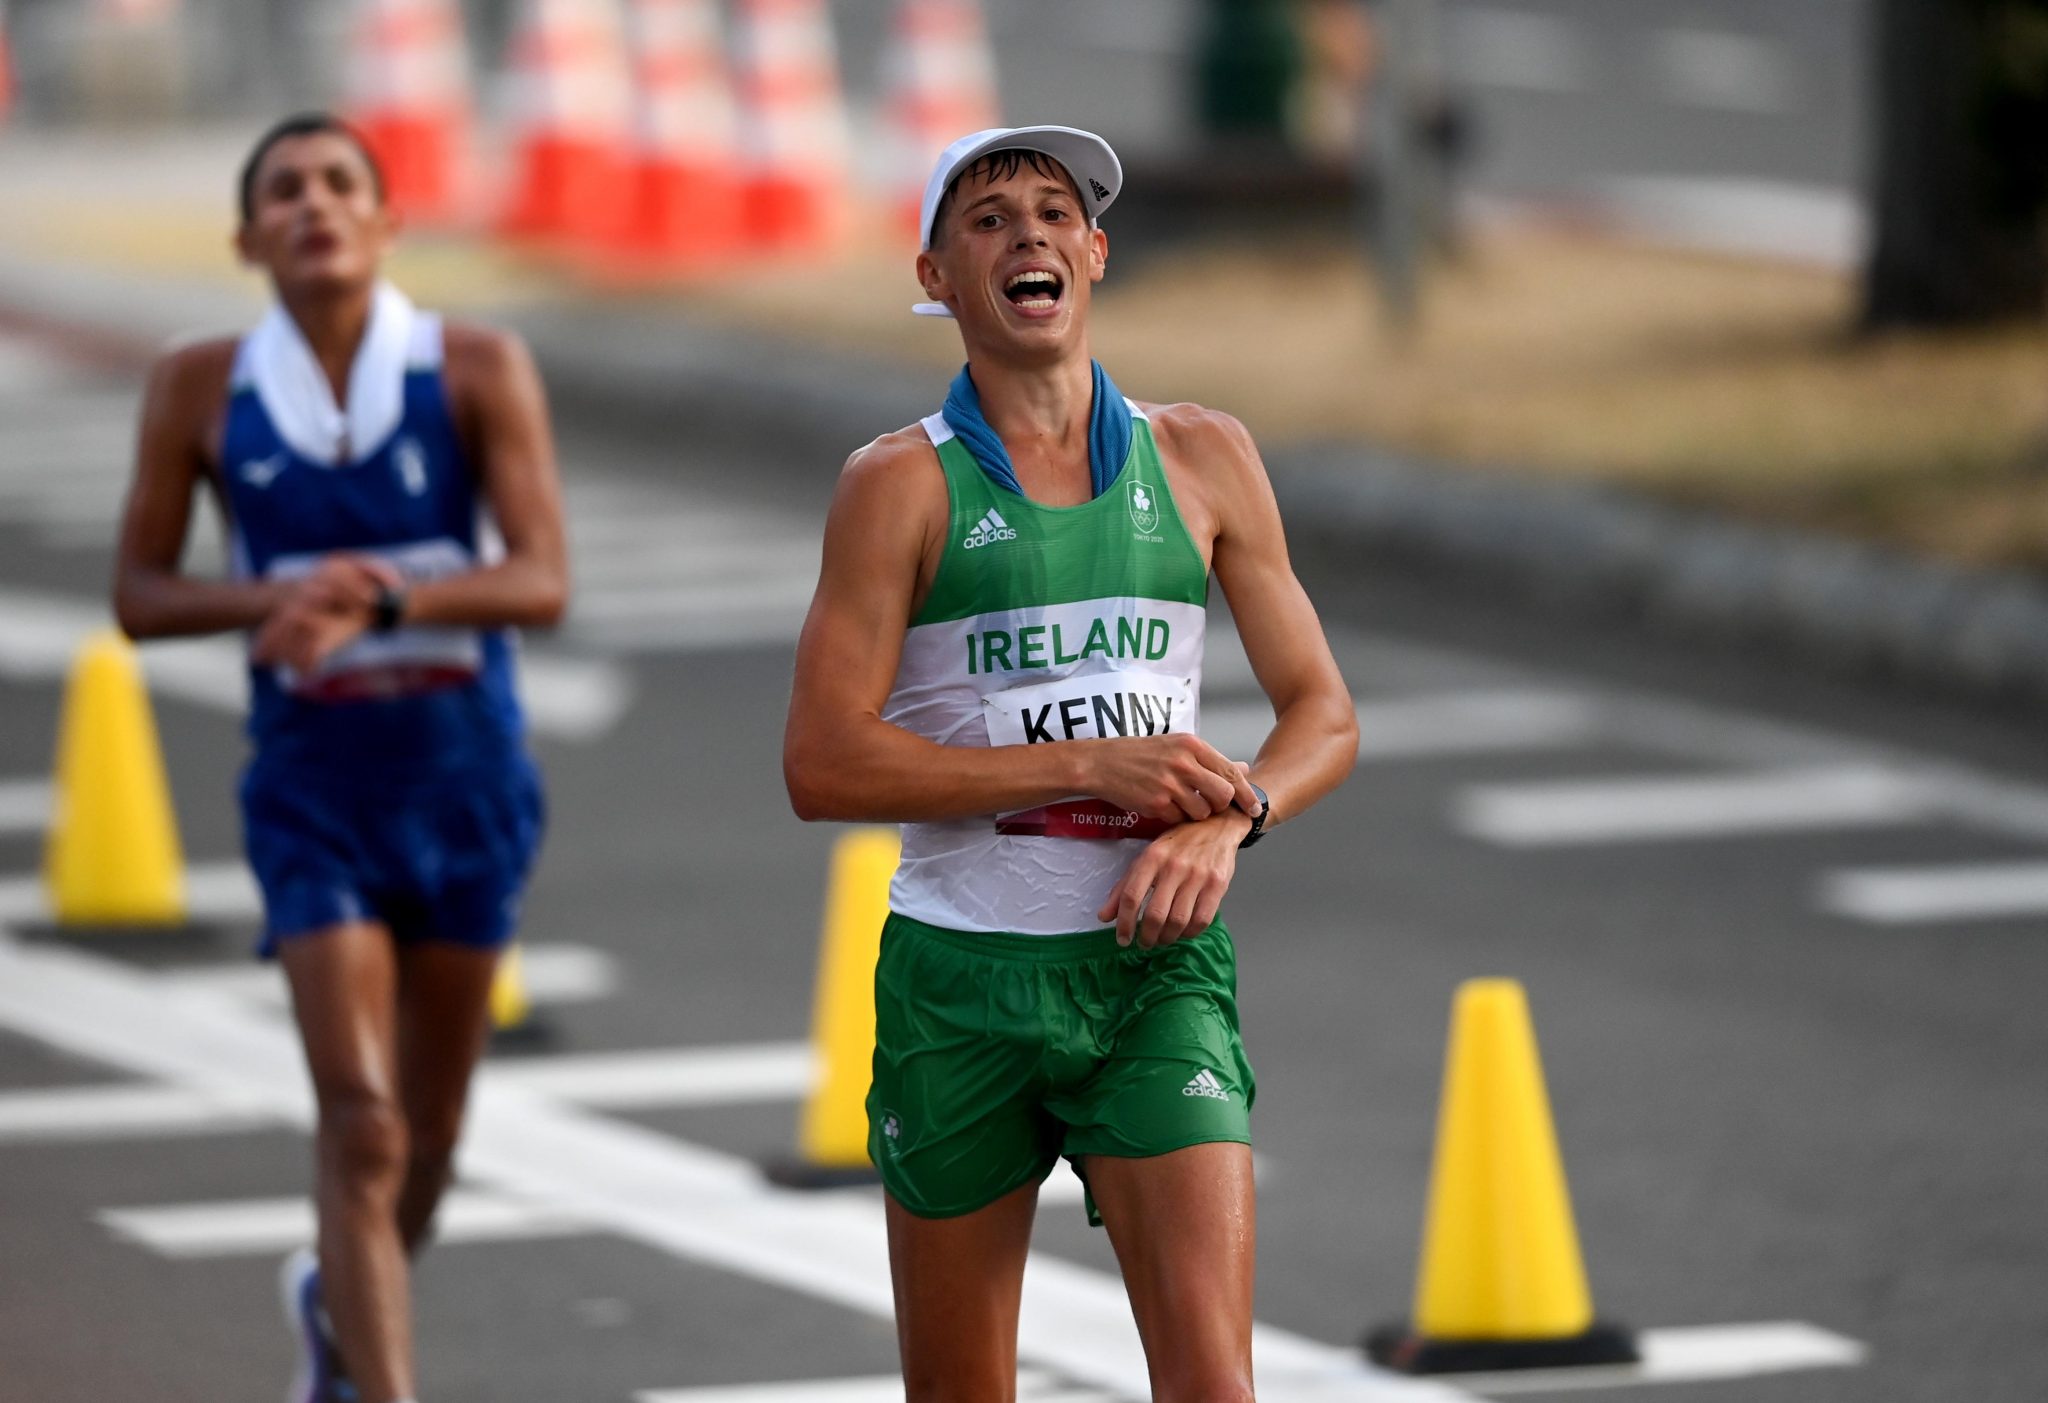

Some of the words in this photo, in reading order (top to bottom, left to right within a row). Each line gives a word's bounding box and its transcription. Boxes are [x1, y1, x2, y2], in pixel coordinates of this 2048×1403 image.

[963, 528, 1017, 549] adidas
[966, 616, 1170, 674] IRELAND
[1021, 692, 1172, 744] KENNY
[1071, 813, 1106, 825] TOKYO
[1108, 815, 1128, 827] 202
